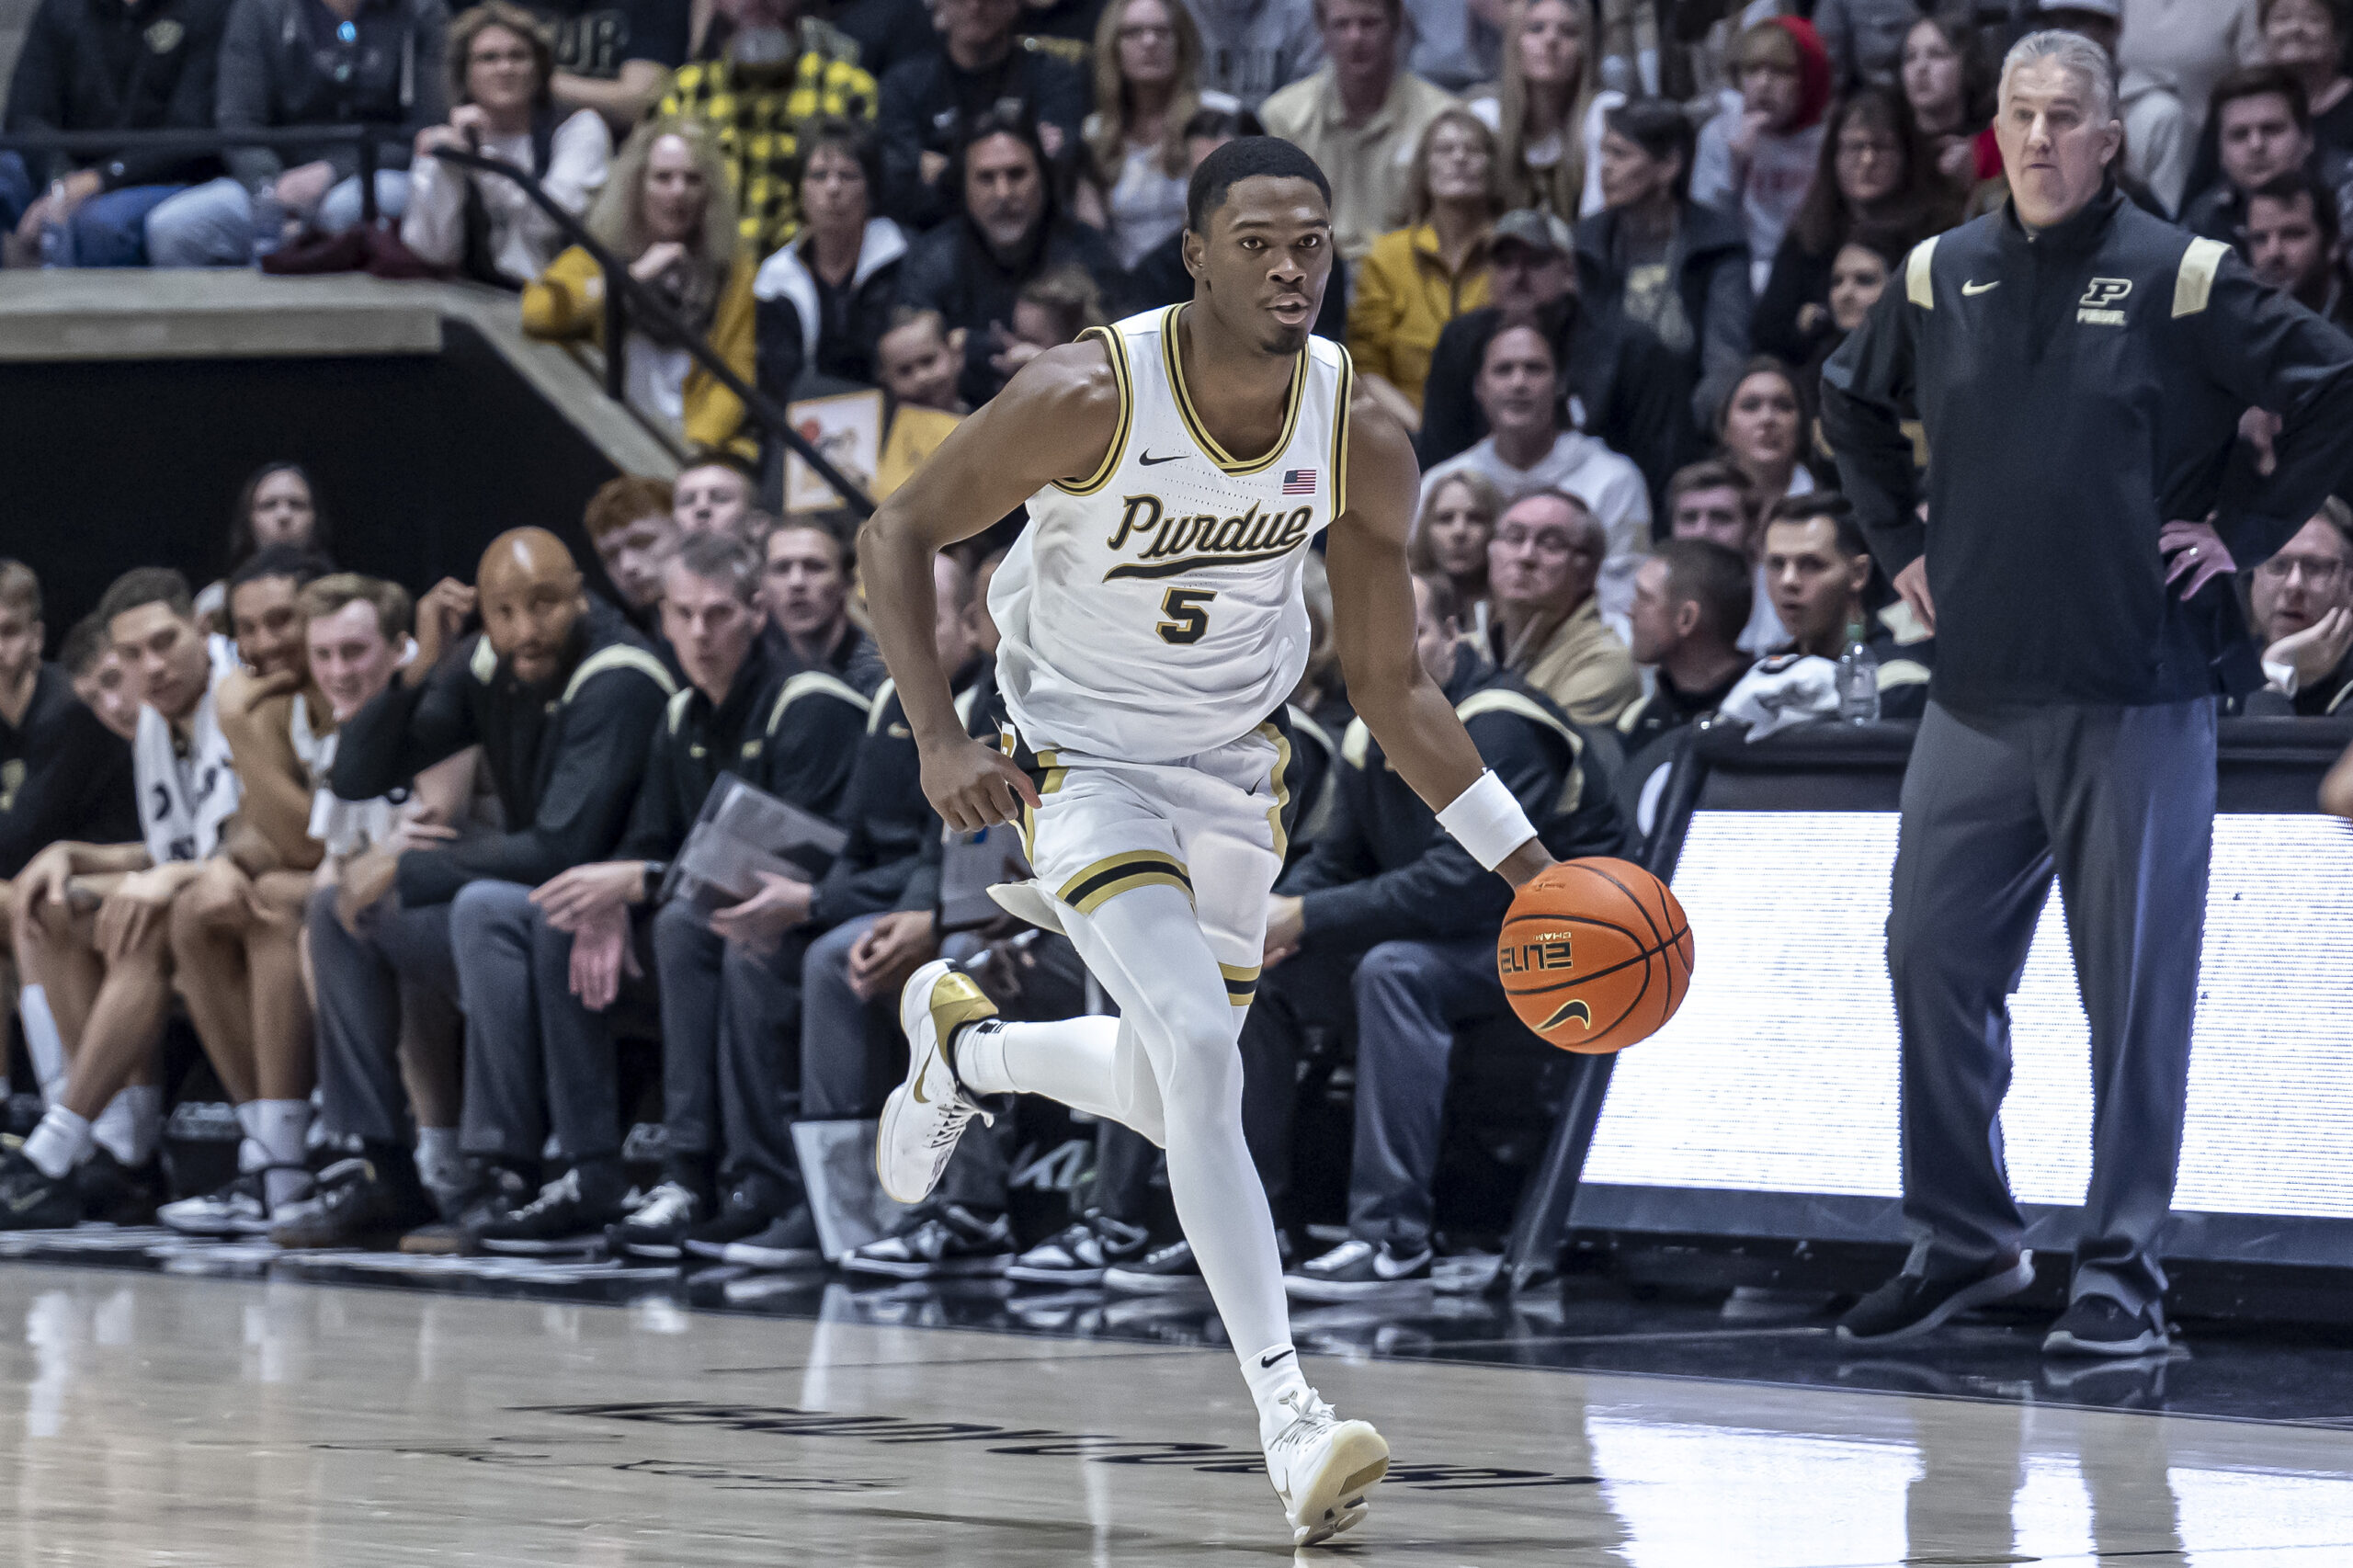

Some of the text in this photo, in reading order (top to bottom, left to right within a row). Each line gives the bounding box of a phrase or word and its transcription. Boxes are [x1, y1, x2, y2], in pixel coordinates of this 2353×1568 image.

[2079, 278, 2132, 307] P
[1107, 494, 1313, 560] Purdue
[1155, 586, 1218, 645] 5
[1500, 941, 1574, 974] ELITE
